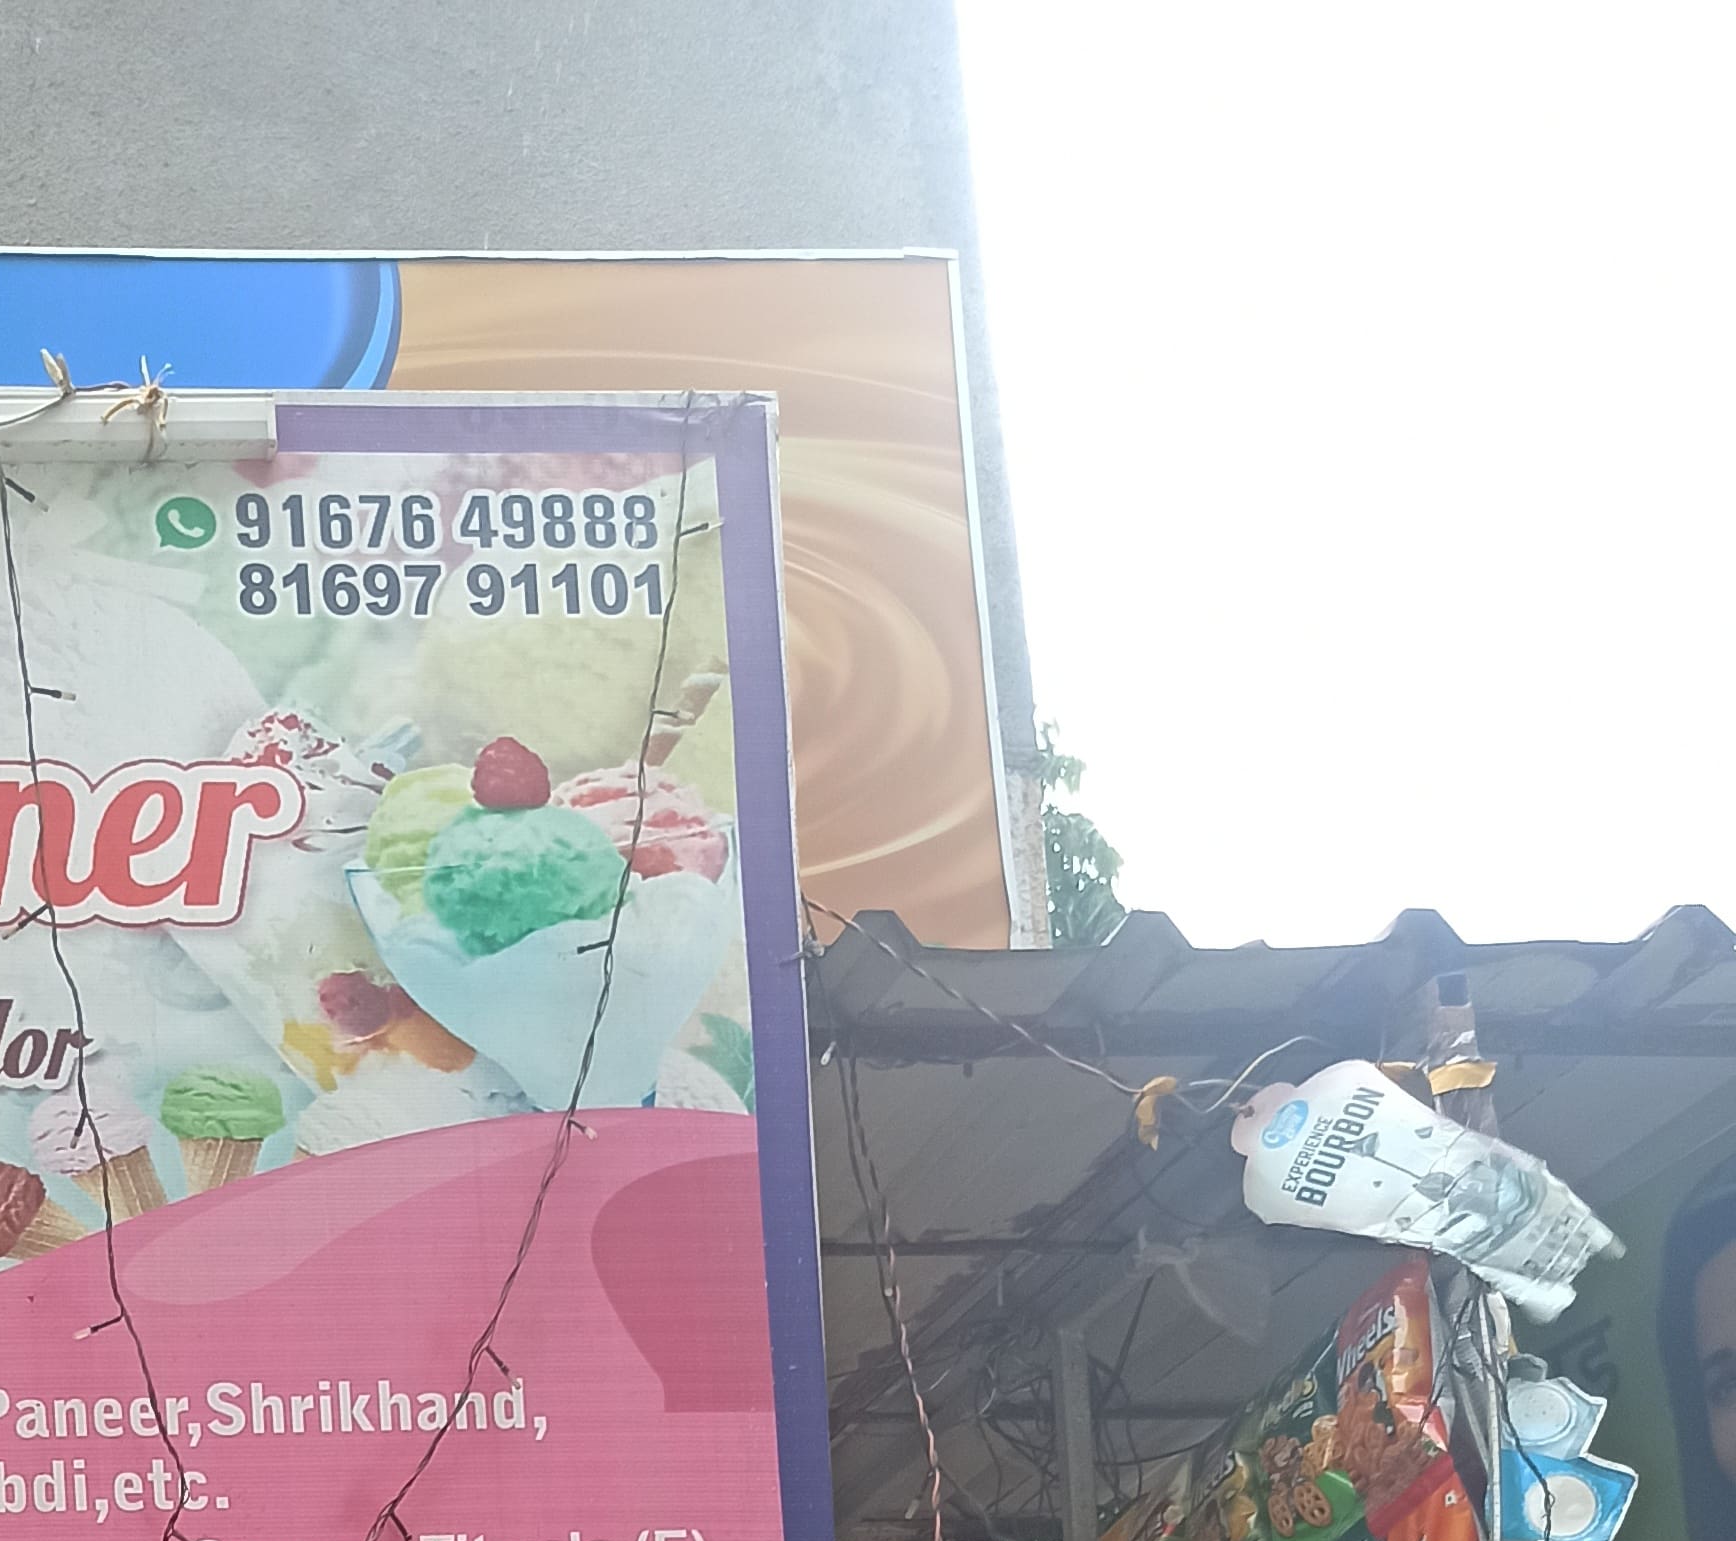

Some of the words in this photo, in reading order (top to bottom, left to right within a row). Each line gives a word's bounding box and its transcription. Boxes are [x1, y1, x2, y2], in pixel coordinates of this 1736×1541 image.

[235, 493, 436, 549] 91676
[459, 493, 658, 549] 49888
[239, 562, 442, 615] 81697
[467, 562, 662, 615] 91101
[1282, 1116, 1333, 1193] EXPERIENCE
[1295, 1087, 1384, 1207] BOURBON
